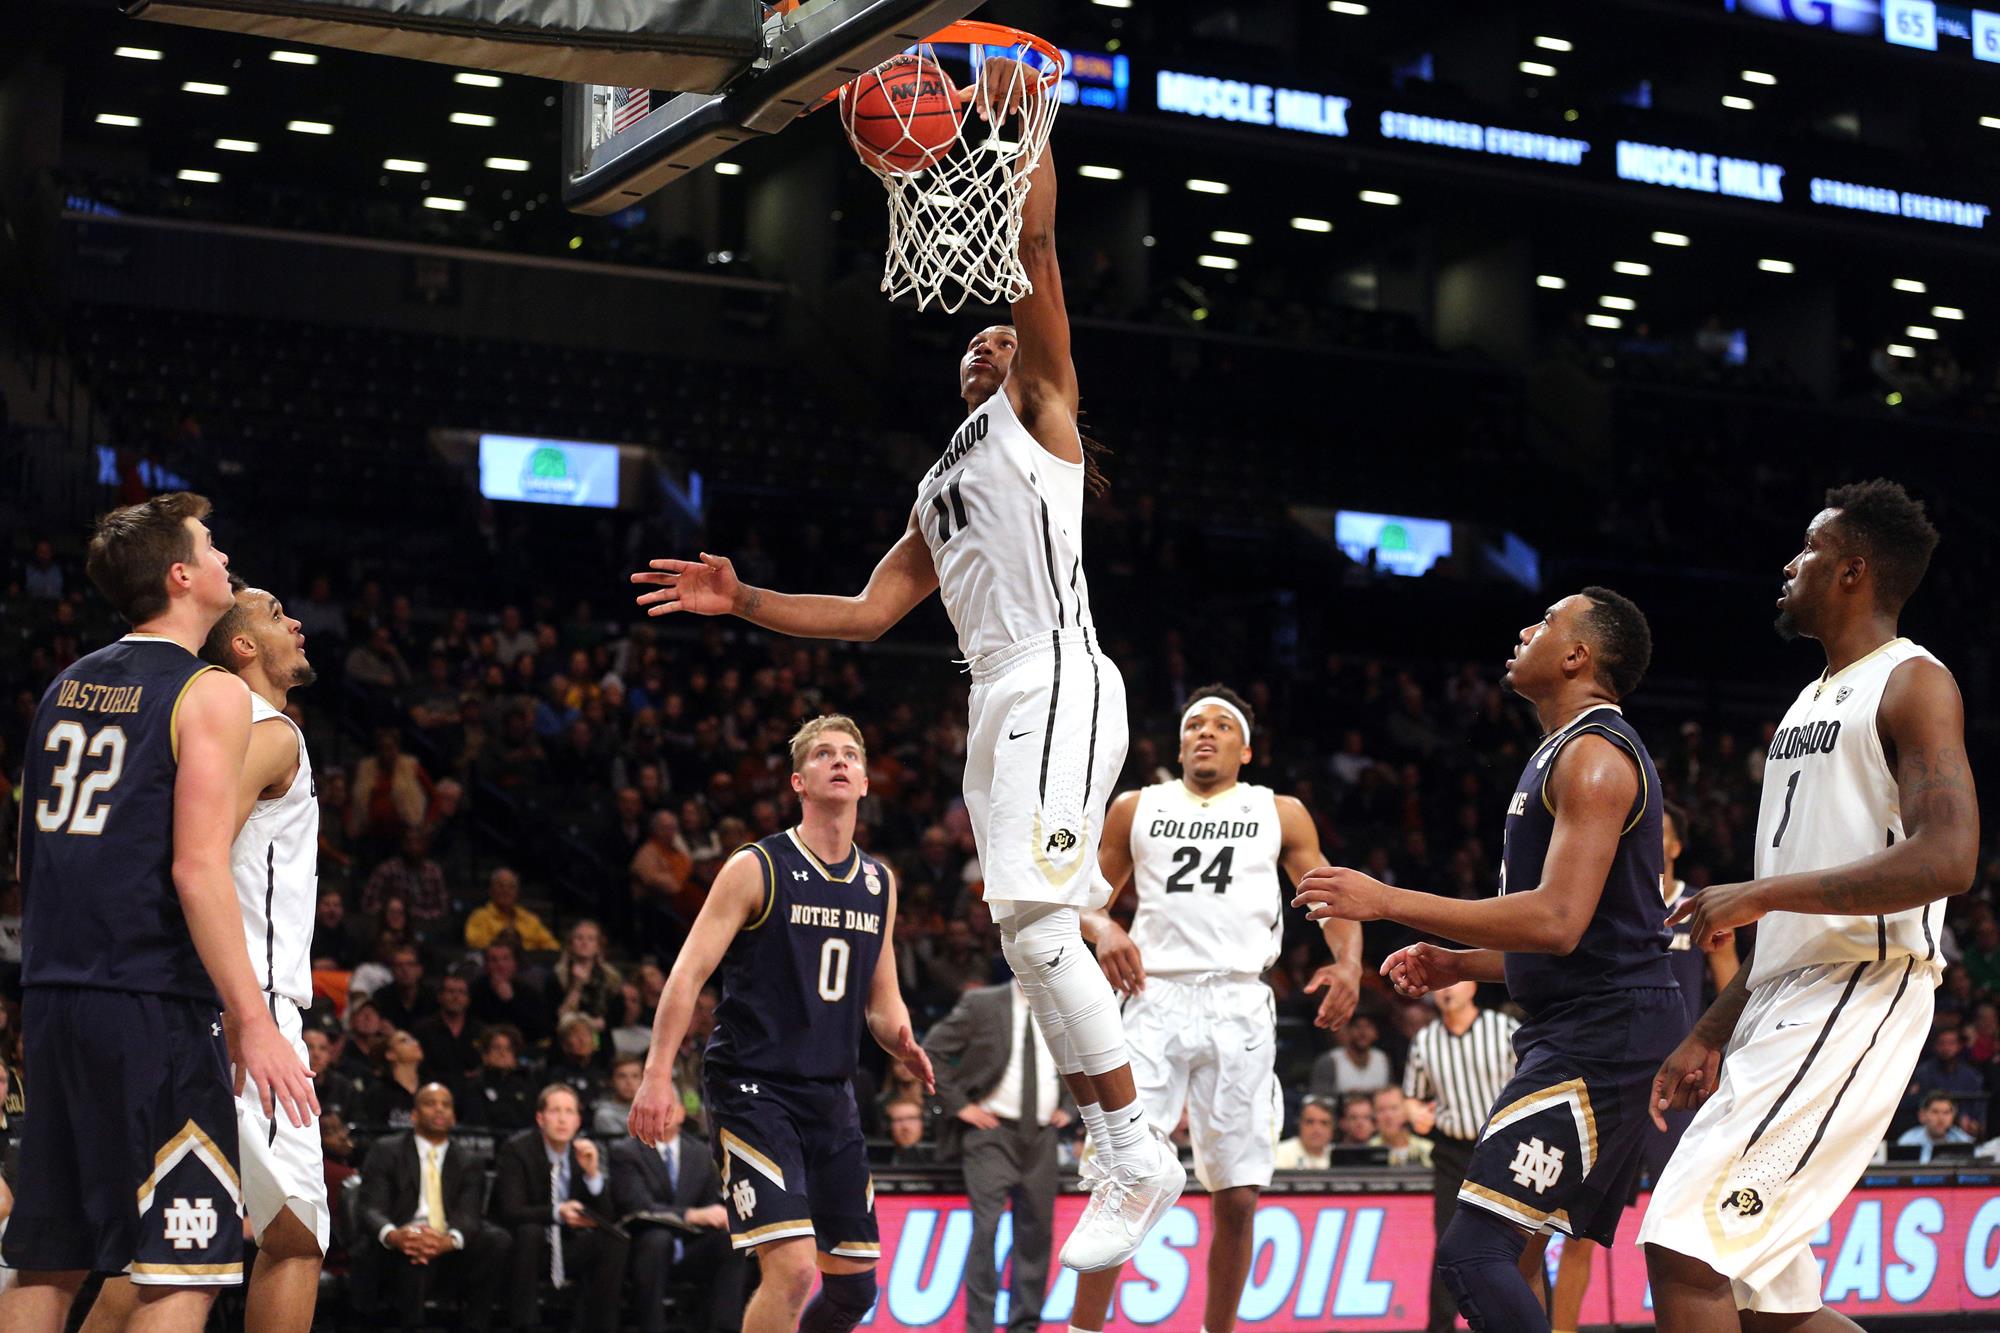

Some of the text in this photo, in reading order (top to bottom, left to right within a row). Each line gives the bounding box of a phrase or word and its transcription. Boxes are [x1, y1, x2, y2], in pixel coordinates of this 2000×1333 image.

[891, 80, 946, 101] NCAA
[1157, 70, 1274, 126] MUSCLE
[1275, 88, 1349, 137] MILK
[1616, 140, 1784, 203] MUSCLE MILK
[932, 467, 969, 544] 11
[56, 679, 144, 713] VASTURIA
[1768, 720, 1842, 760] OLORADO
[35, 719, 128, 835] 32
[1772, 769, 1801, 848] 1
[1150, 819, 1259, 840] COLORADO
[1166, 846, 1235, 894] 24
[790, 904, 880, 935] NOTRE DAME
[818, 937, 850, 1002] 0
[1236, 1206, 1395, 1323] OIL
